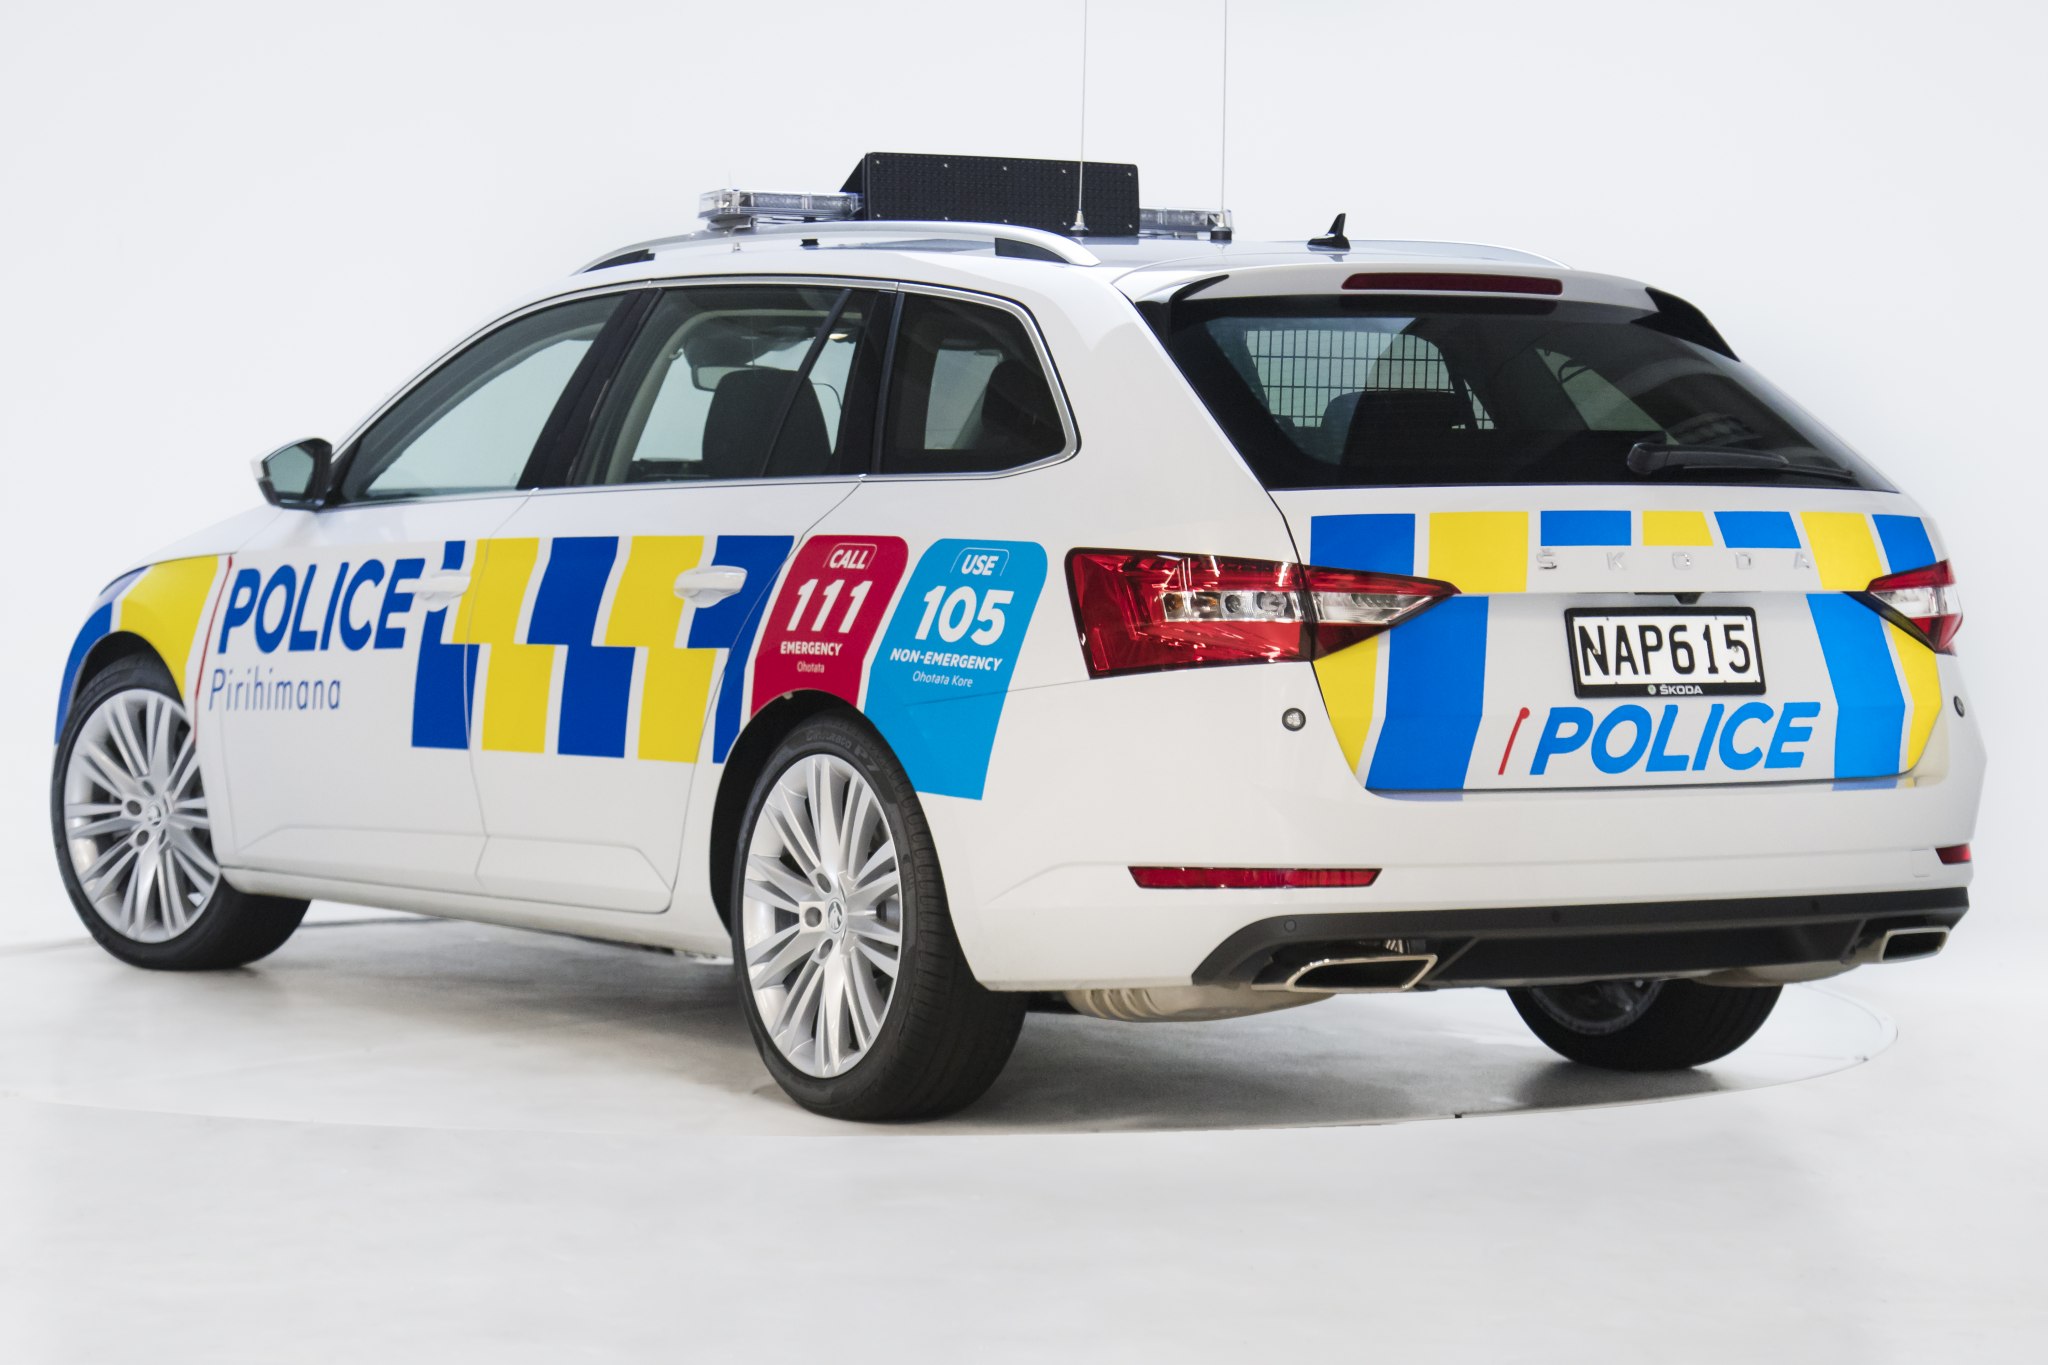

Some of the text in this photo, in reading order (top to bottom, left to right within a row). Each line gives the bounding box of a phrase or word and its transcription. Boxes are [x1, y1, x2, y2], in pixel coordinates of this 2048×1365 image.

[829, 549, 870, 569] CALL
[961, 554, 999, 576] USE
[217, 558, 426, 654] POLICE
[786, 578, 873, 634] 111
[915, 585, 1015, 646] 105
[780, 641, 843, 656] EMERGENCY
[890, 648, 1003, 672] NON-EMERGENCY
[1578, 624, 1752, 676] NAP615
[797, 661, 825, 673] Ohotata
[912, 670, 973, 688] Ohotata Kore
[208, 666, 342, 712] Pirihimana
[1659, 684, 1704, 695] ŠKODA
[1529, 701, 1821, 775] POLICE
